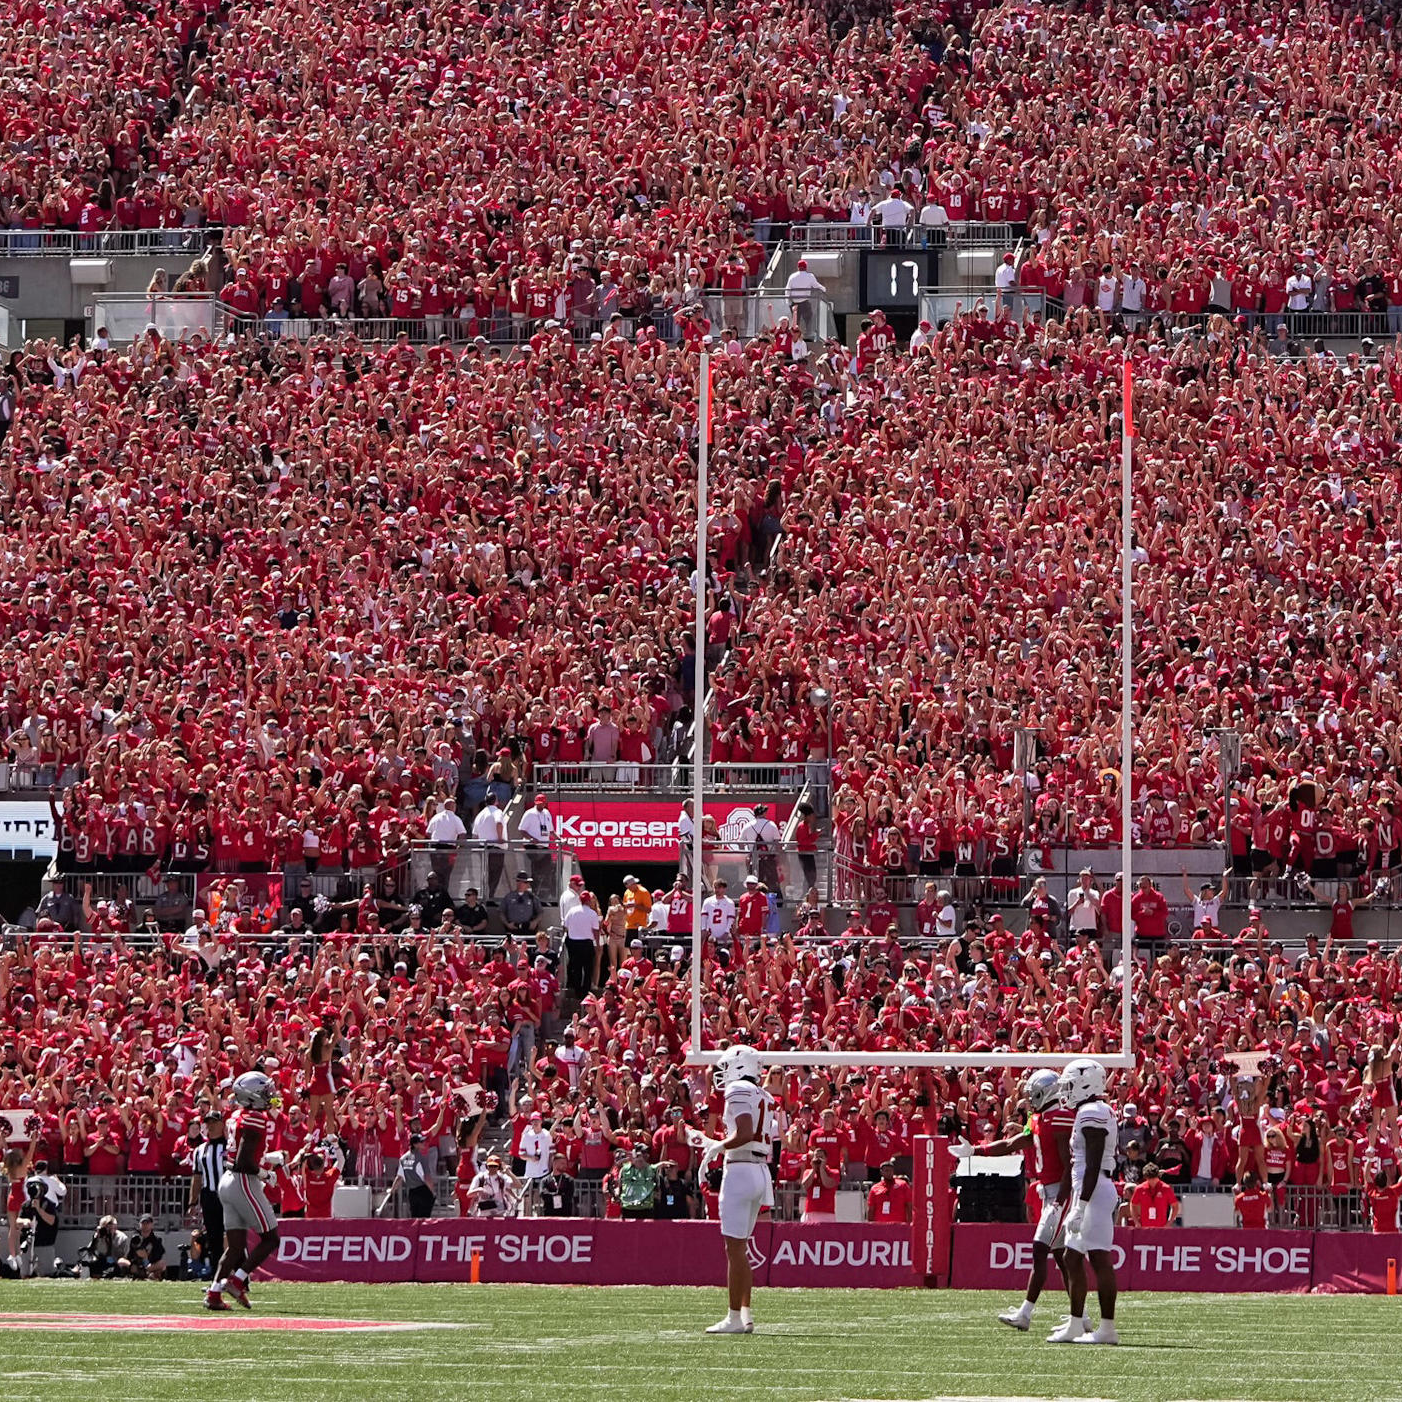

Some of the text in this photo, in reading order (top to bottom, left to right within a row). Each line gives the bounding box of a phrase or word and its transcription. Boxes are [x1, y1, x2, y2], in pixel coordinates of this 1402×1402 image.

[890, 260, 919, 297] 17
[594, 836, 680, 848] & SECURITY
[925, 1139, 935, 1276] OHIO STATE
[277, 1234, 593, 1263] DEFEND THE 'SHOE
[772, 1240, 912, 1268] ANDURIL
[1133, 1244, 1202, 1271] THE
[1205, 1245, 1311, 1274] 'SHOE
